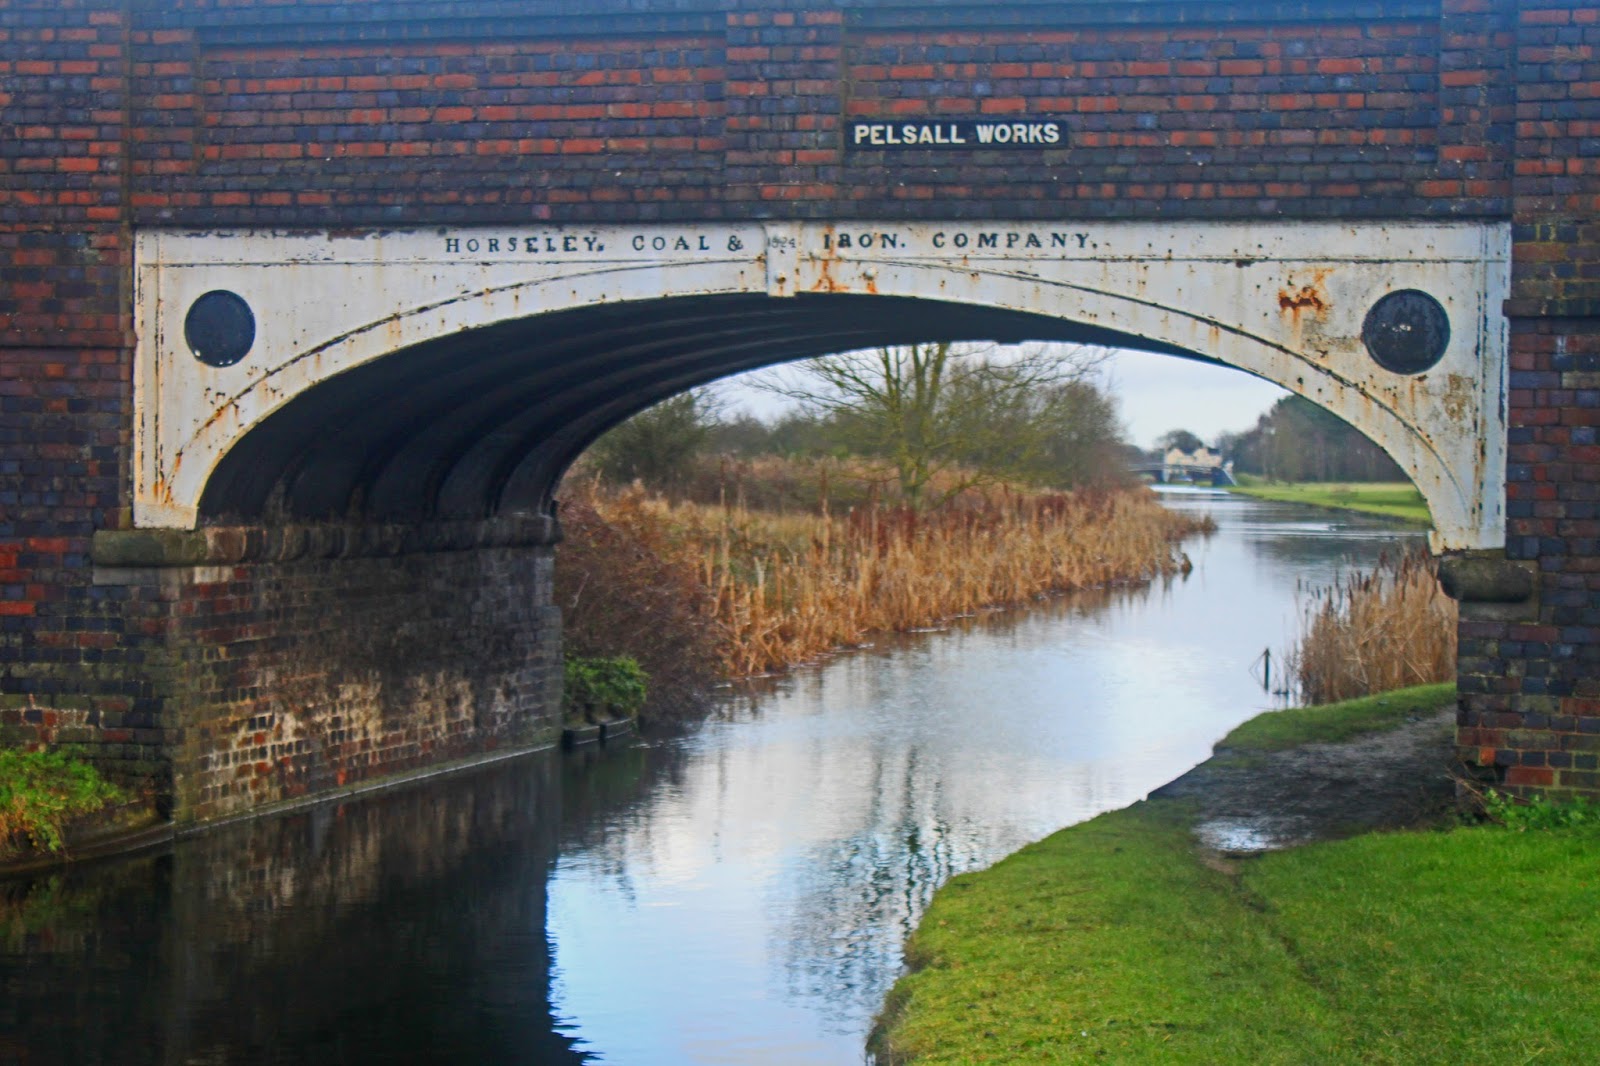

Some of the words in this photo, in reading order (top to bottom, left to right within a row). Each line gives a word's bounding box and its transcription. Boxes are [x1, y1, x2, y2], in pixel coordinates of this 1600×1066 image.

[854, 124, 966, 145] PELSALL
[976, 123, 1060, 143] WORKS
[631, 235, 710, 251] COAL
[727, 235, 744, 251] &
